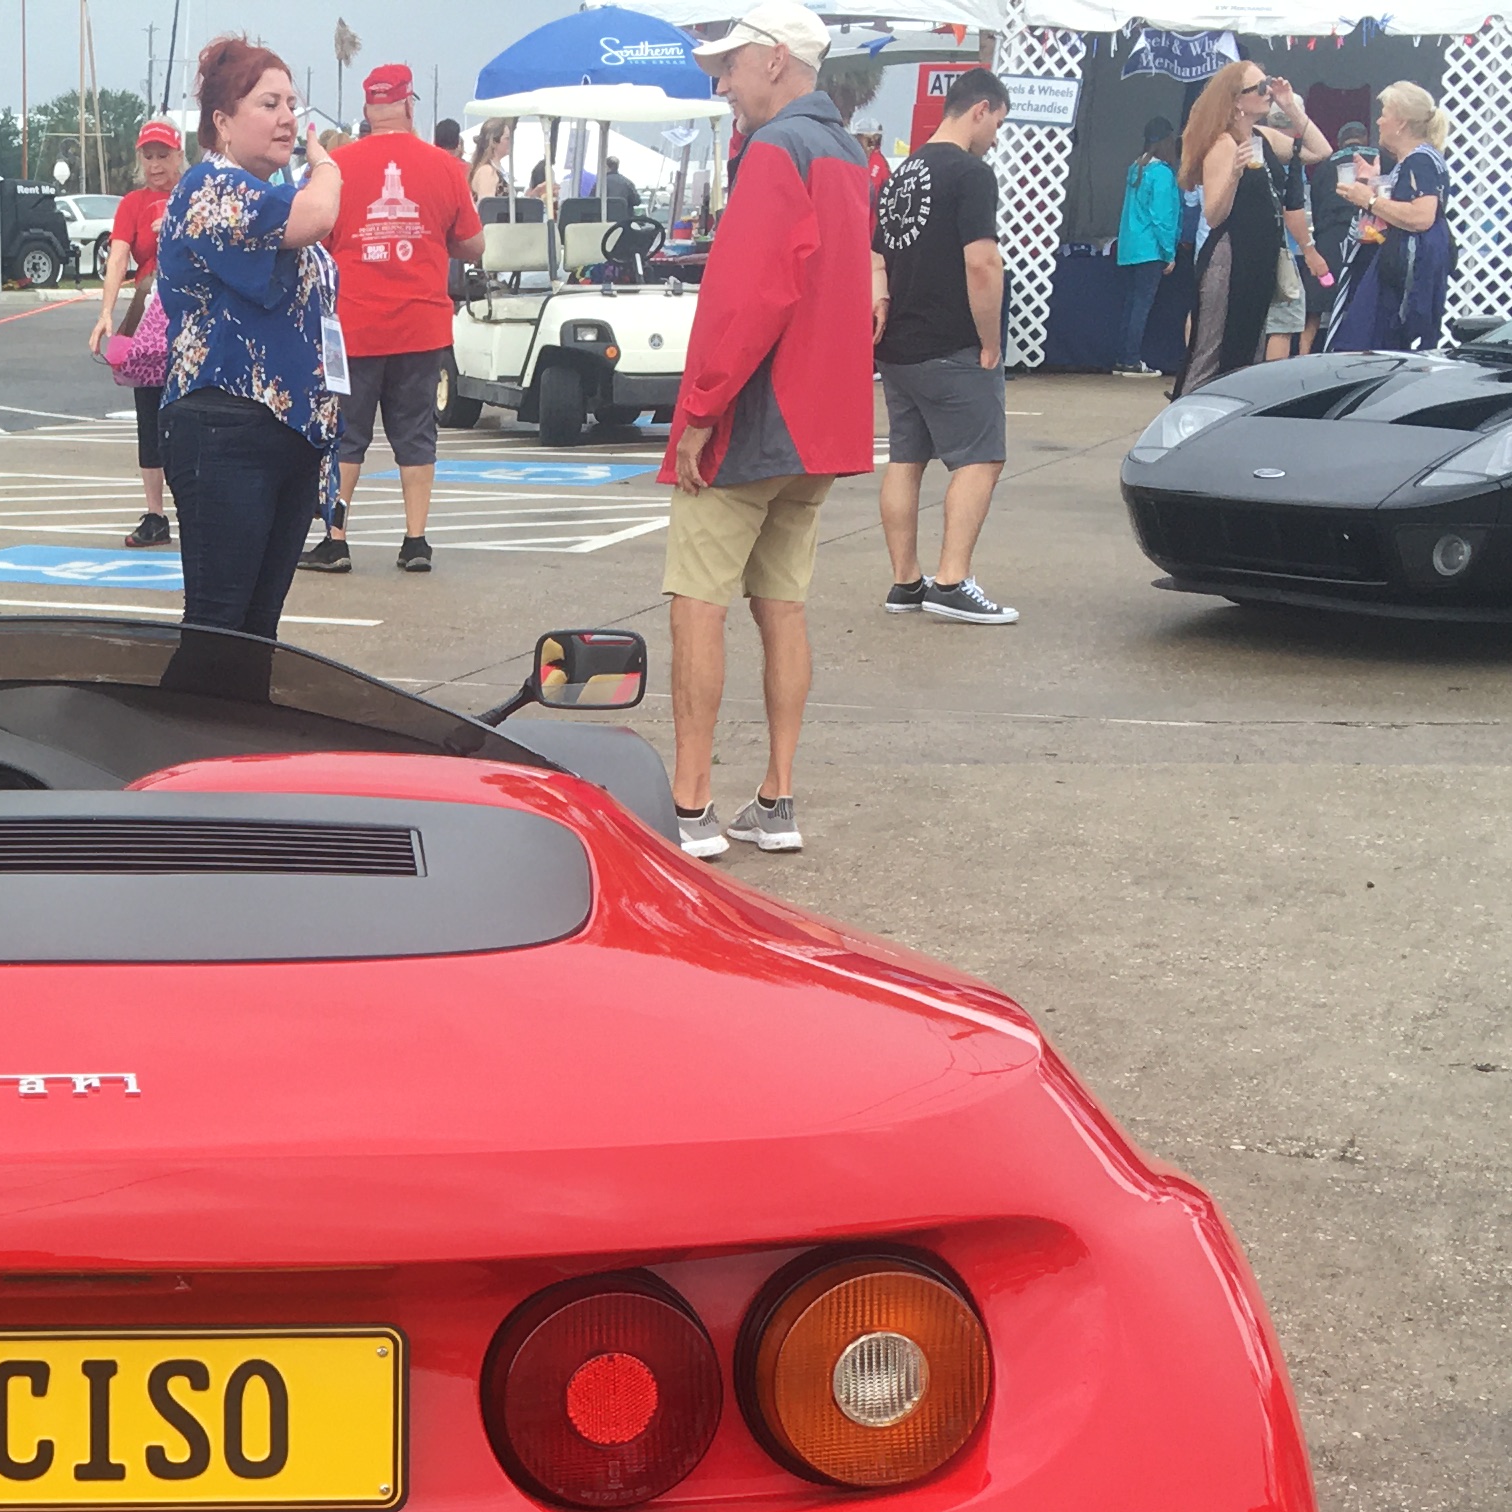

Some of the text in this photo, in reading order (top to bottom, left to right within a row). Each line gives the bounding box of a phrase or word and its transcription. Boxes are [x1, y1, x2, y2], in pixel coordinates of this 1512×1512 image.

[599, 37, 685, 65] Southern
[1172, 39, 1182, 56] &
[930, 74, 960, 95] AT
[1006, 83, 1074, 98] eels & Wheels
[1010, 100, 1069, 115] erchandise
[16, 185, 56, 194] Rent Me
[904, 177, 917, 192] TX
[918, 196, 931, 226] THE
[363, 251, 388, 260] LIGHT
[367, 245, 385, 253] BUD
